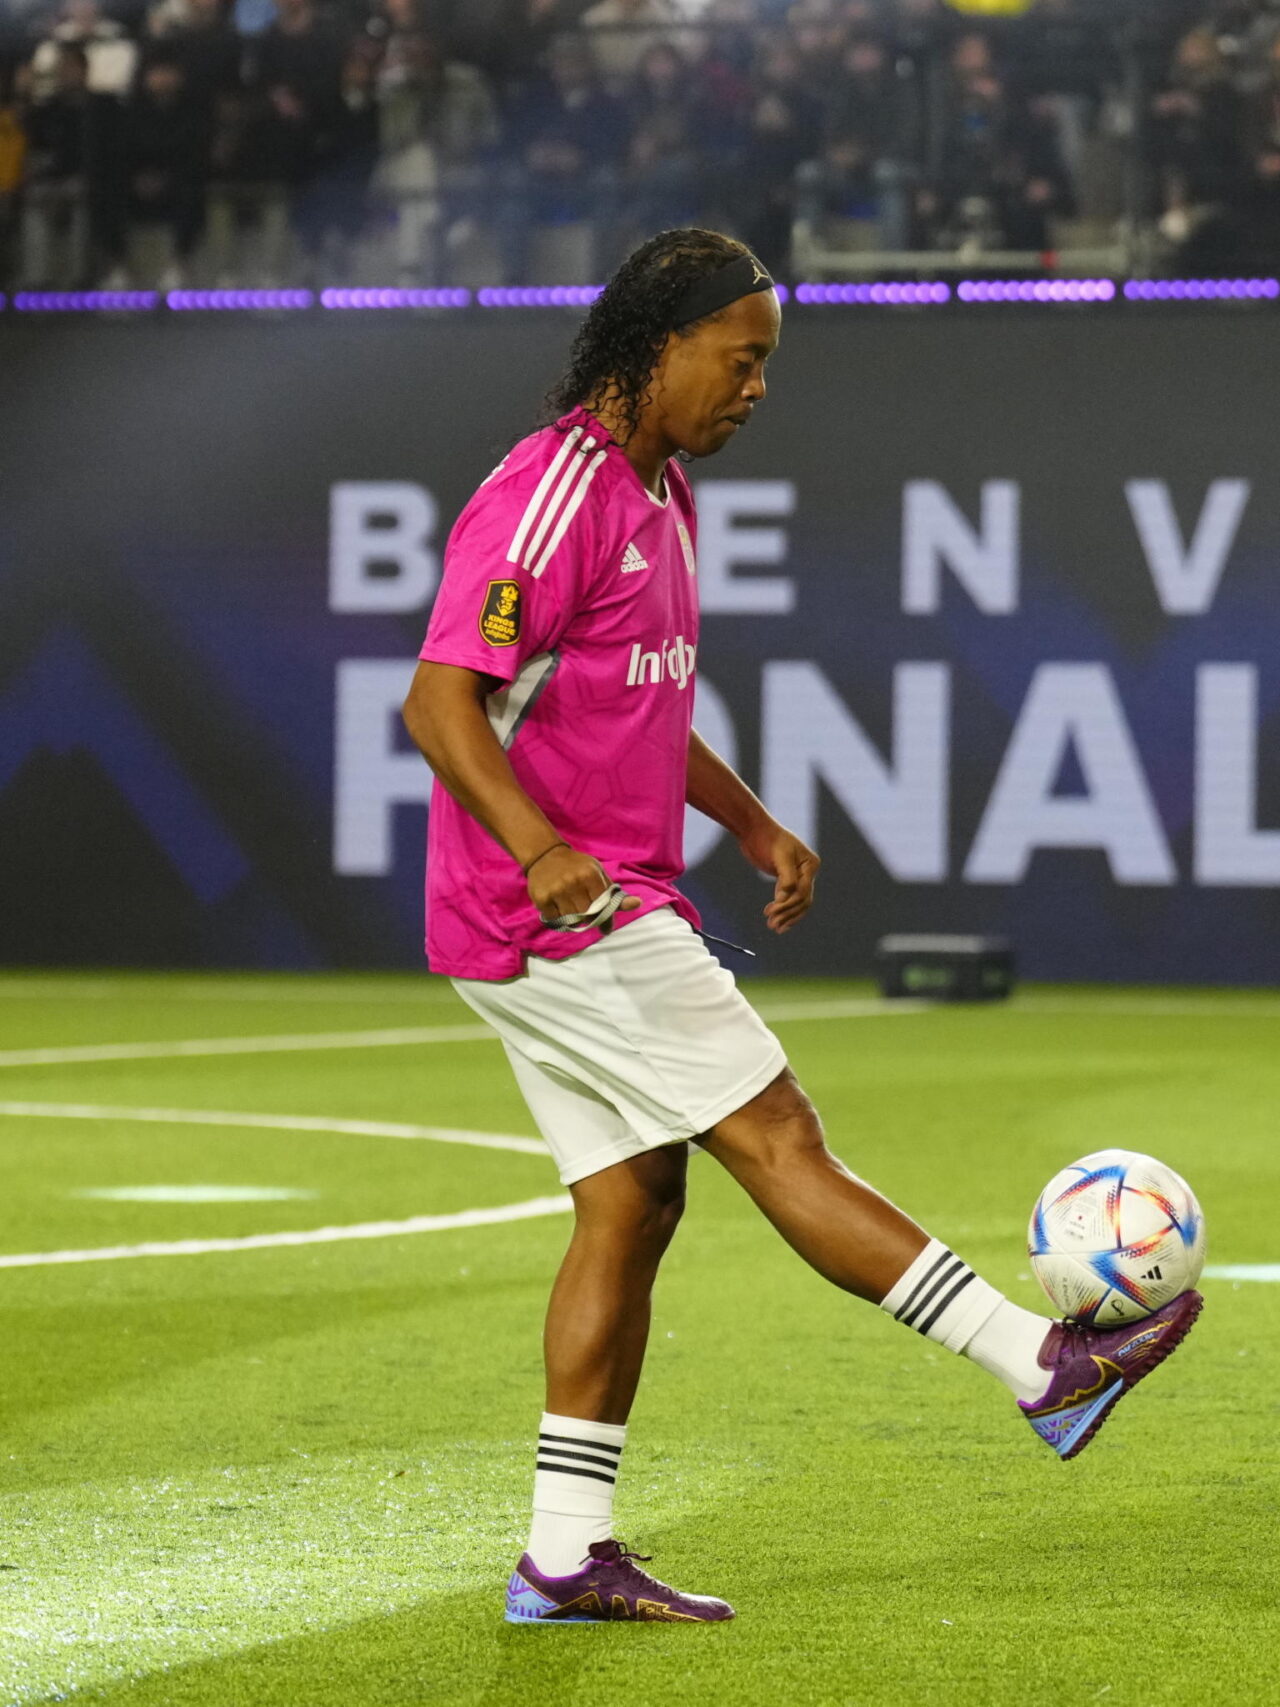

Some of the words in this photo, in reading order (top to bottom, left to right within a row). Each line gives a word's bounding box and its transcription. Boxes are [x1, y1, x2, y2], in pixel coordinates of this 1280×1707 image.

[620, 559, 649, 574] adidas
[484, 620, 516, 636] LEAGUE
[488, 614, 515, 628] KINGS
